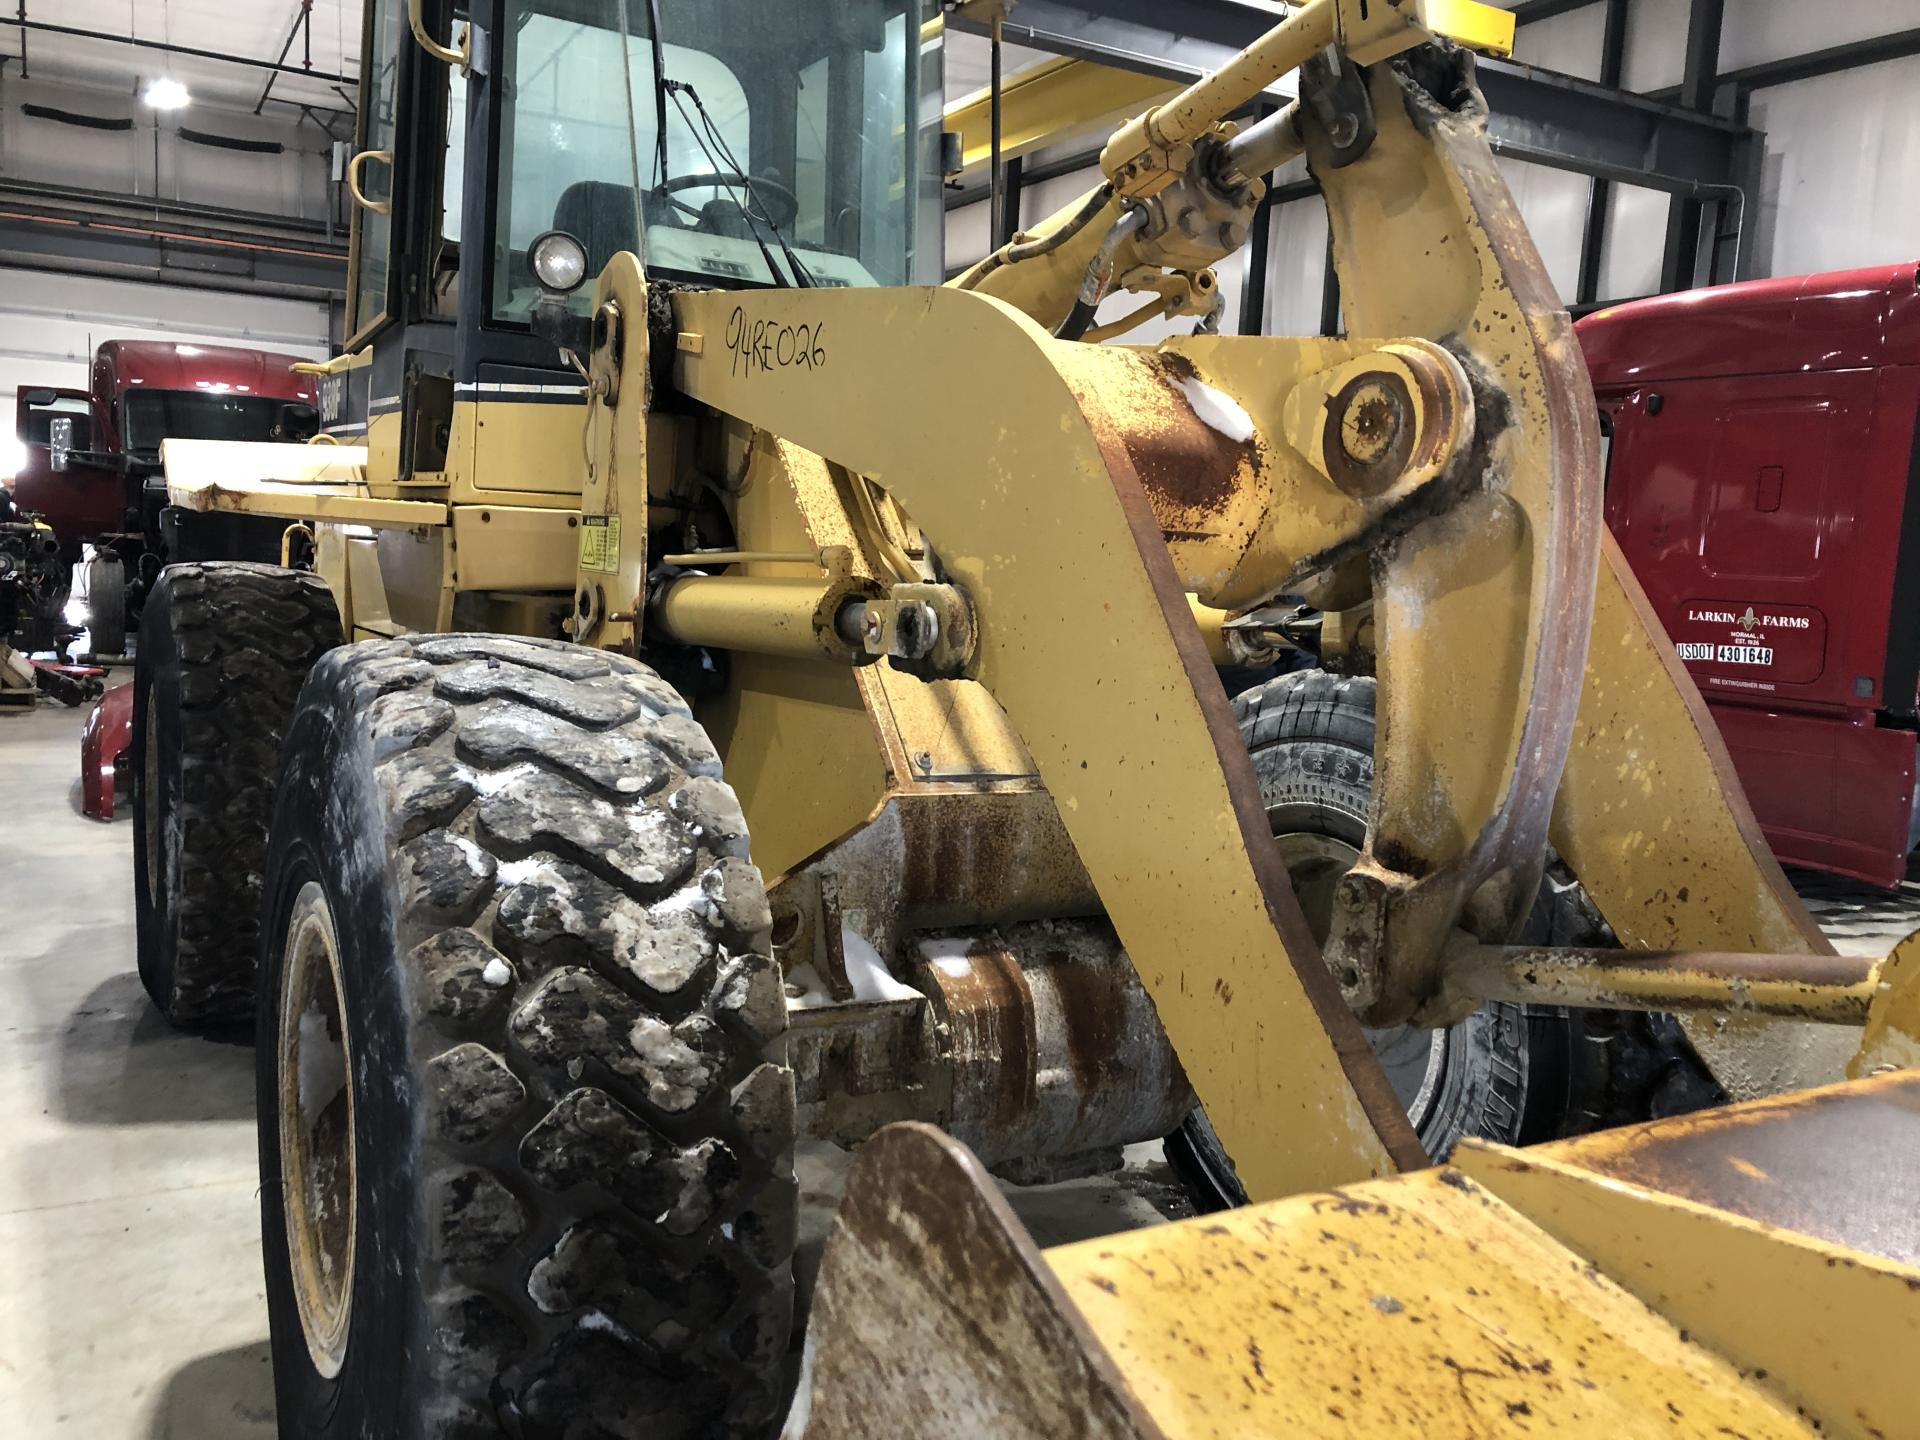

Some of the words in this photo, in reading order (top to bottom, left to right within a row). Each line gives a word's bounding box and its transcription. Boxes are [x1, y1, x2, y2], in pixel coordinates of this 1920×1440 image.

[1689, 610, 1736, 623] LARKIN
[1763, 615, 1810, 629] FARMS
[1677, 644, 1712, 658] USDOT
[1720, 648, 1771, 663] 4301648
